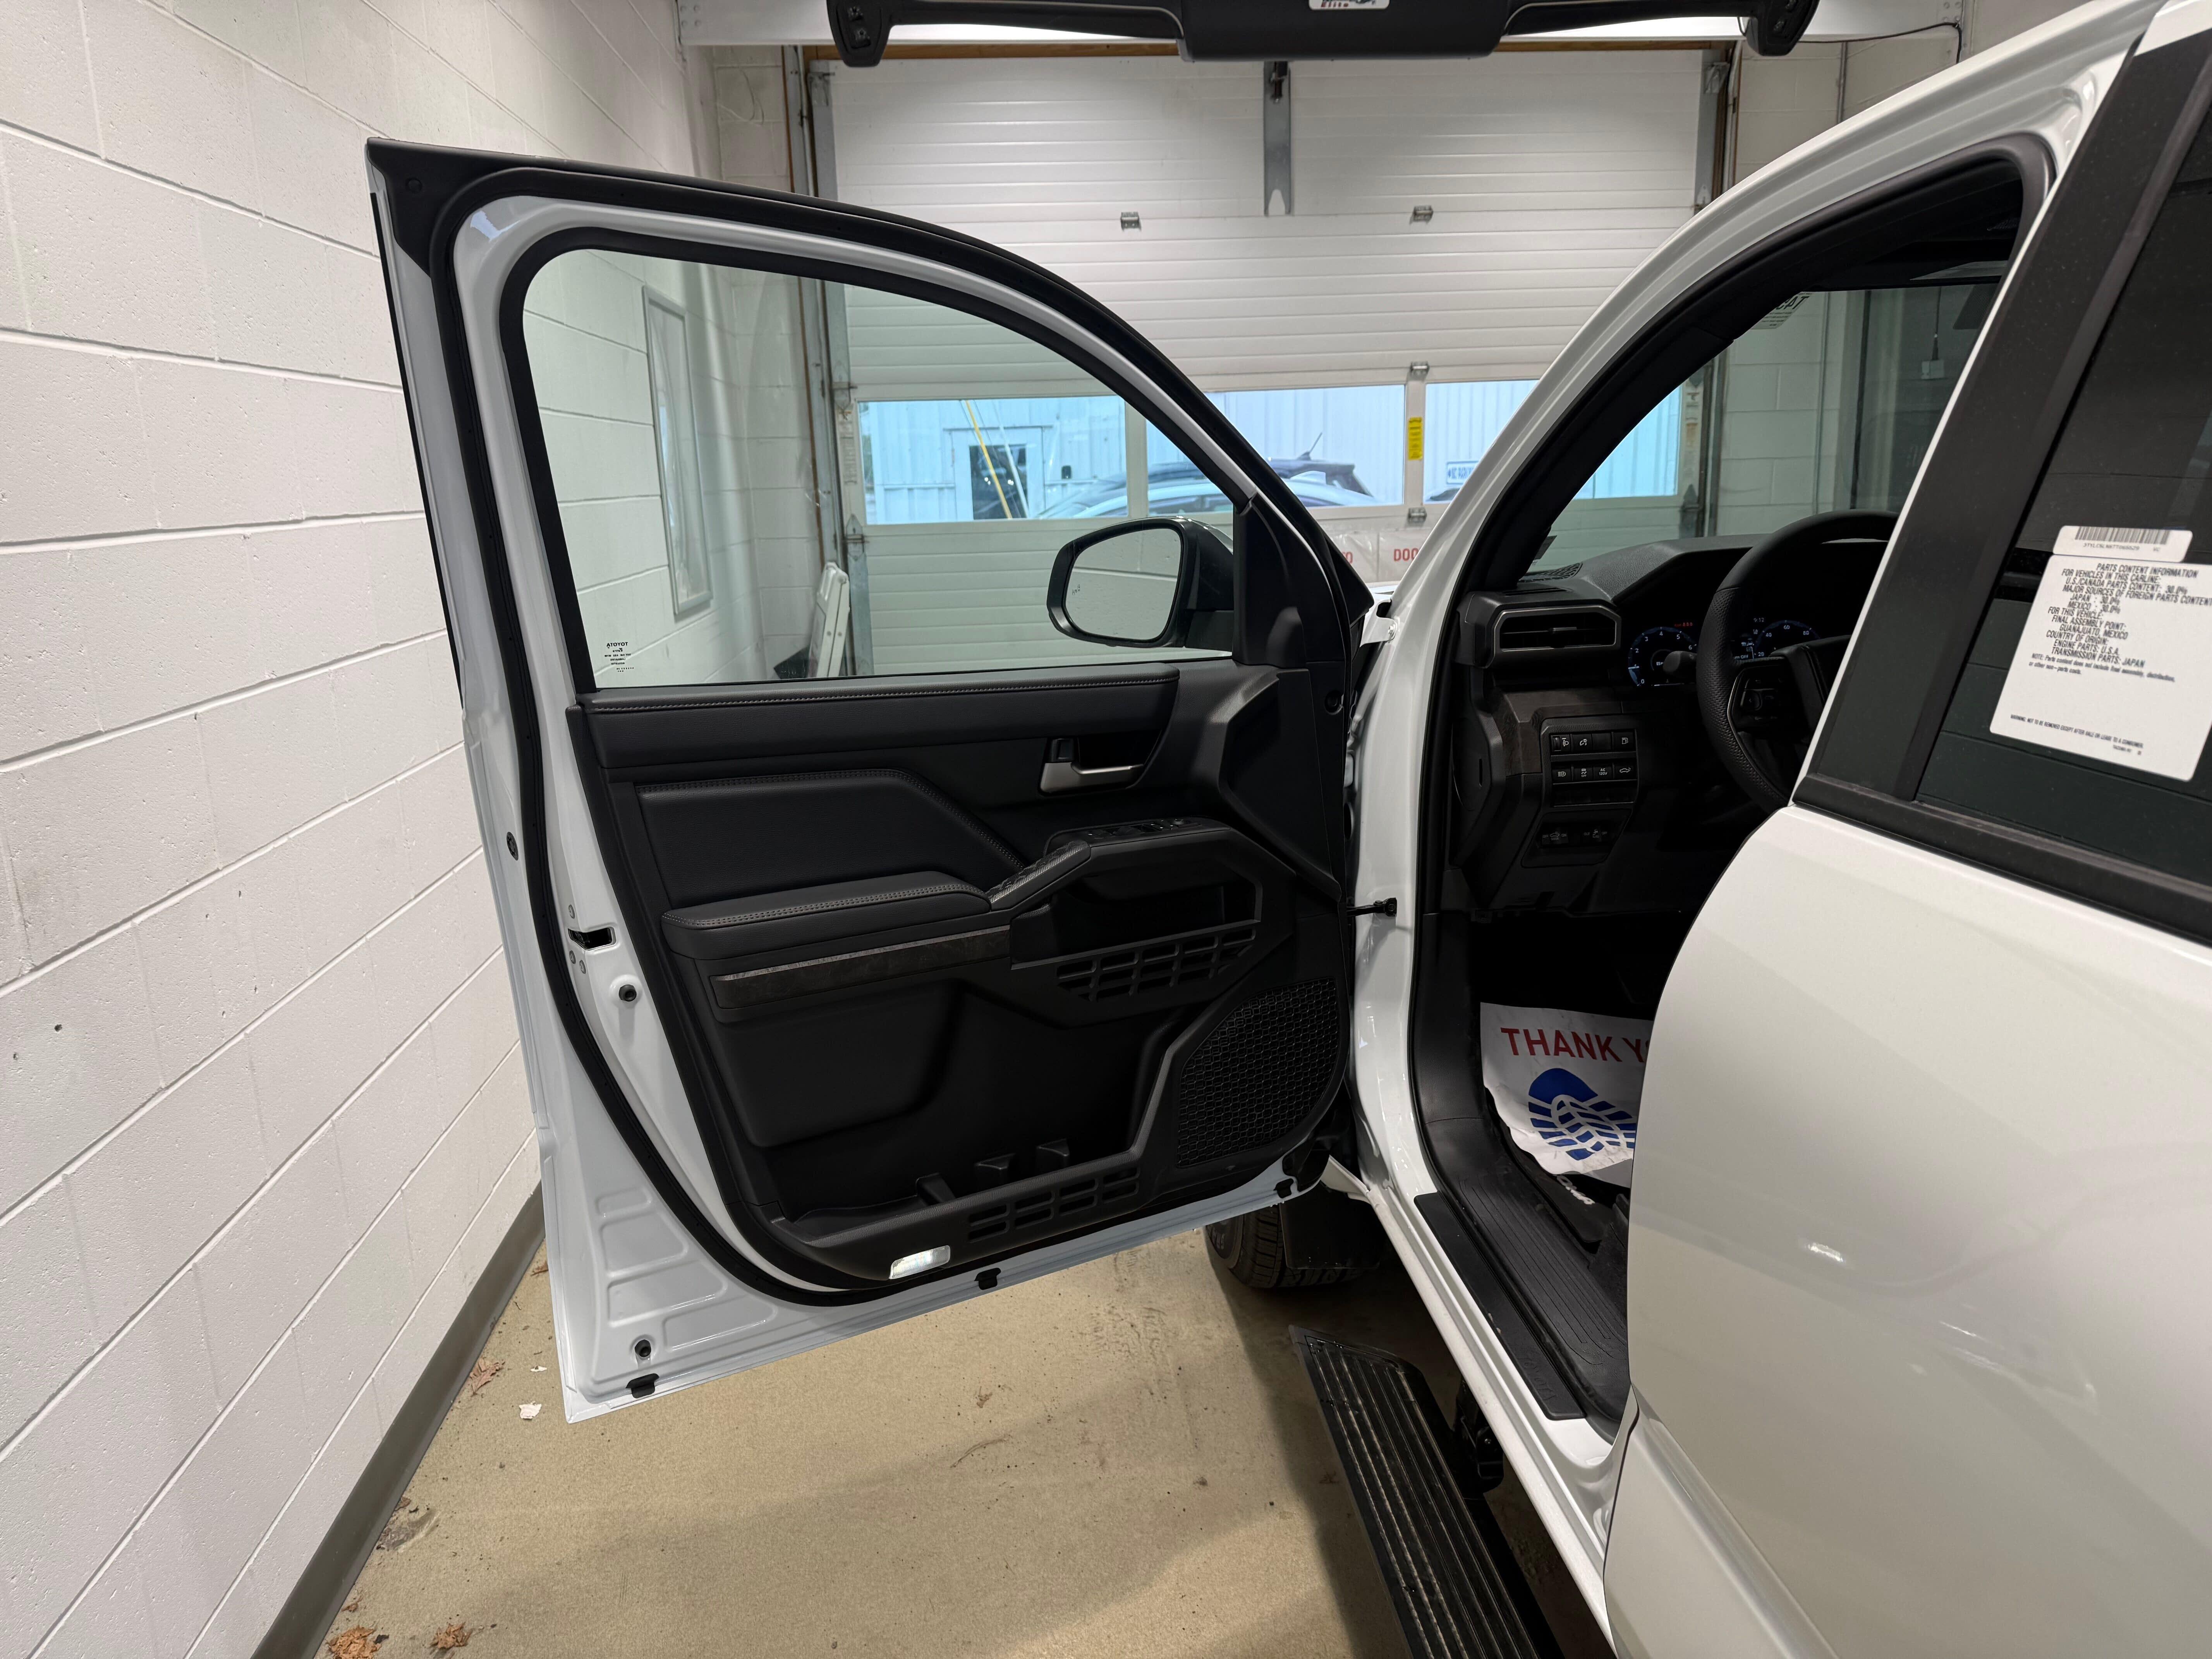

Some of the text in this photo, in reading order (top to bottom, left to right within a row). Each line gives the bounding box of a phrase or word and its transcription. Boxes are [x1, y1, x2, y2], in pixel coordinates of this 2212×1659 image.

[2061, 568, 2074, 577] FOR
[2075, 569, 2104, 579] VEHICLES
[2114, 572, 2129, 581] THIS
[2130, 574, 2161, 584] CARLINE:
[2096, 563, 2199, 578] PARTS CONTENT INFORMATION
[2066, 577, 2105, 587] U.S./CANADA
[2106, 580, 2128, 590] PARTS
[2129, 582, 2161, 592] CONTENT:
[2063, 584, 2085, 593] MAJOR
[2085, 586, 2114, 597] SOURCES
[2115, 589, 2125, 597] OF
[2125, 590, 2155, 600] FOREIGN
[2155, 593, 2179, 603] PARTS
[2070, 593, 2091, 602] JAPAN
[2048, 606, 2104, 620] FOR THIS VEHICLE:
[2067, 601, 2092, 610] MEXICO
[2052, 615, 2126, 631] FINAL ASSEMBLY POINT:
[2046, 630, 2075, 640] COUNTRY
[2077, 634, 2085, 642] OF
[2102, 629, 2129, 640] MEXICO
[2054, 639, 2077, 649] ENGINE
[2077, 642, 2100, 653] PARTS:
[2052, 646, 2146, 668] TRANSMISSION PARTS: JAPAN
[1500, 1027, 1649, 1063] THANK Y
